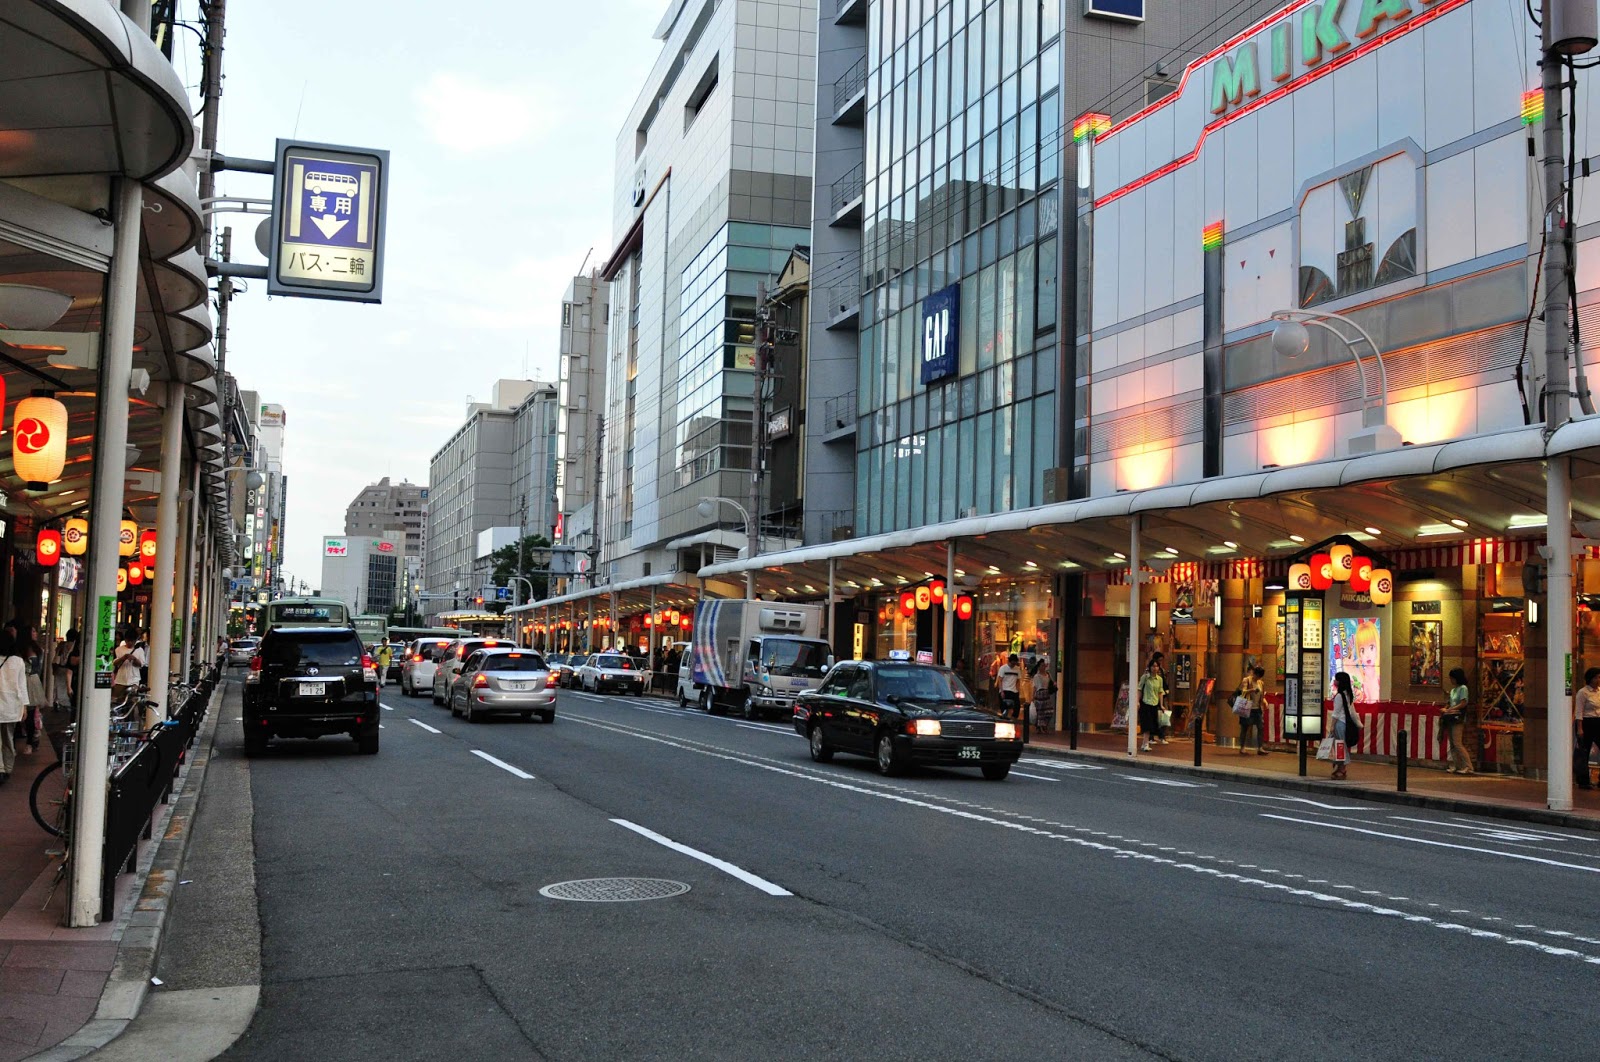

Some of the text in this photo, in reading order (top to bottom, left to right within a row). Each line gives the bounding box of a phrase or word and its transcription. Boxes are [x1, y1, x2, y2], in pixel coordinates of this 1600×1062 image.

[1210, 0, 1437, 114] MIKA
[309, 195, 352, 215] 専用
[288, 251, 366, 276] バス・二輪
[925, 308, 949, 362] GAP
[1341, 594, 1371, 603] MIKADO
[316, 608, 329, 617] 37
[961, 750, 980, 758] 99-52
